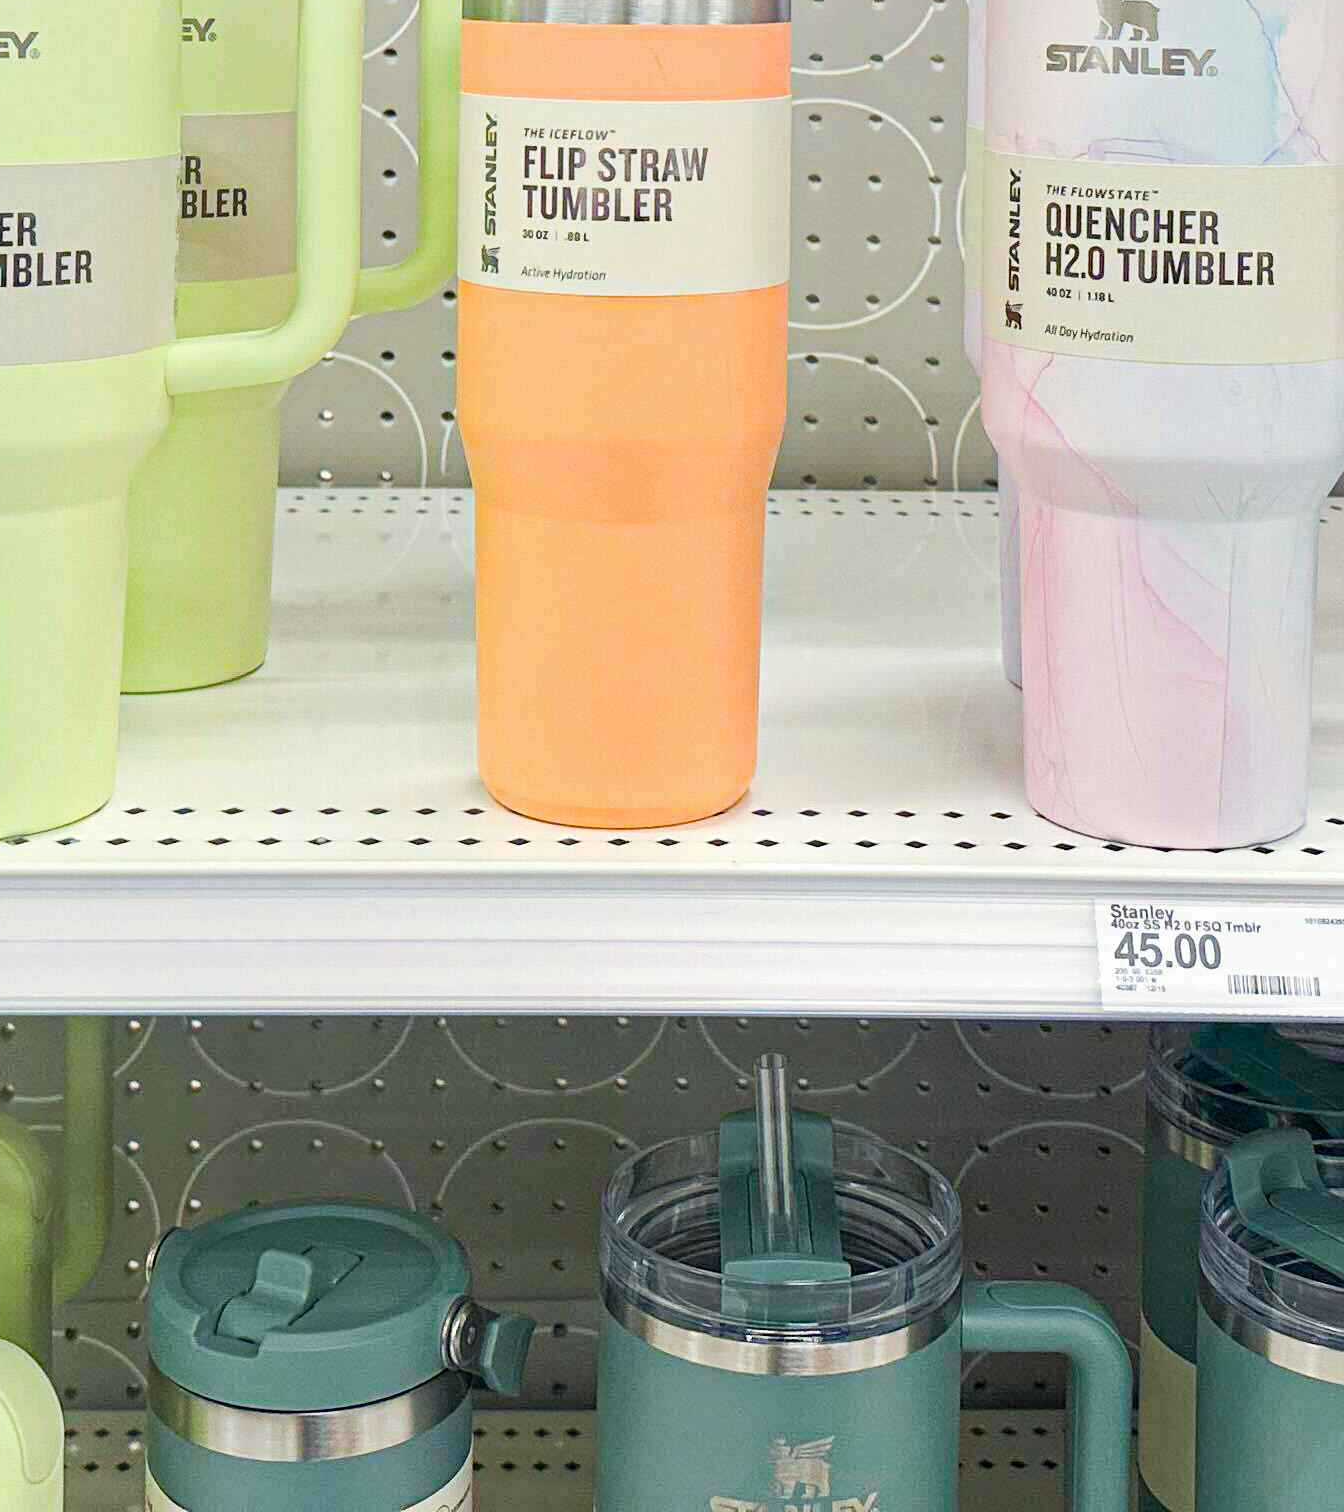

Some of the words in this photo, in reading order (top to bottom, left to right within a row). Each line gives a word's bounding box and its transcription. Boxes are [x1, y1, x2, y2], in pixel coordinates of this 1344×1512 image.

[524, 128, 545, 139] THE
[485, 112, 499, 236] STANLEY
[524, 146, 587, 180] FLIP
[597, 147, 708, 182] STRAW
[1046, 185, 1067, 196] THE
[522, 184, 673, 222] TUMBLER
[1009, 168, 1022, 291] STANLEY
[1046, 203, 1219, 245] QUENCHER
[522, 229, 533, 239] 30
[536, 230, 548, 240] OZ
[583, 233, 590, 242] L
[521, 266, 551, 278] Active
[553, 268, 606, 281] Hydration
[1046, 243, 1104, 280] H2.0
[1118, 248, 1275, 286] TUMBLER
[1046, 288, 1058, 299] 40
[1060, 290, 1072, 300] OZ
[1107, 293, 1115, 303] L
[1045, 324, 1057, 336] All
[1059, 326, 1078, 340] Day
[1080, 327, 1134, 344] Hydration
[1110, 904, 1174, 920] Stanley
[1111, 919, 1139, 930] 40oz
[1143, 920, 1159, 930] SS
[1195, 921, 1222, 933] FSQ
[1225, 922, 1261, 933] Tmblr
[1114, 931, 1222, 969] 45.00
